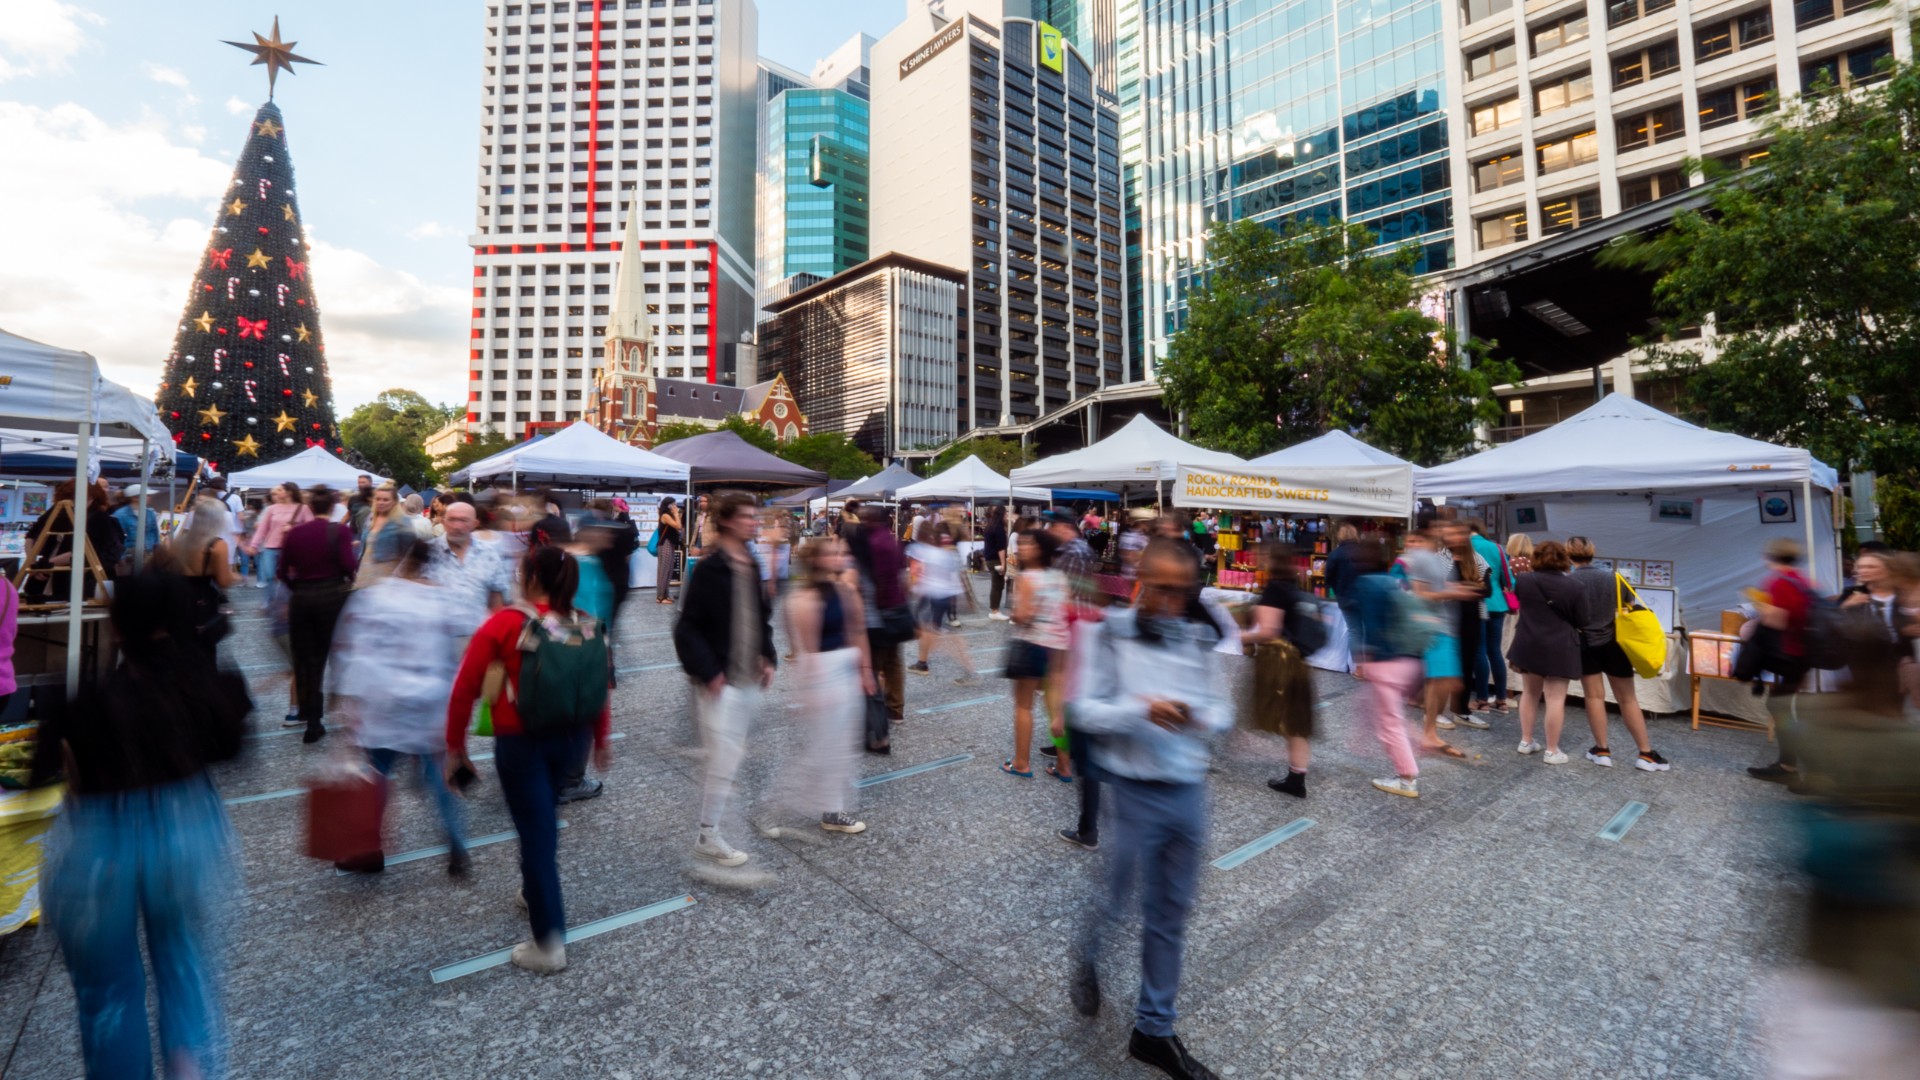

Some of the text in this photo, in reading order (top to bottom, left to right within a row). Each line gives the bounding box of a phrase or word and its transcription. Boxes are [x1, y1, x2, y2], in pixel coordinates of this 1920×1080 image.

[909, 25, 961, 69] SHINE LAWYERS
[1187, 473, 1281, 487] ROCKY ROAD &
[1186, 486, 1330, 501] HANDCRAFTED SWEETS
